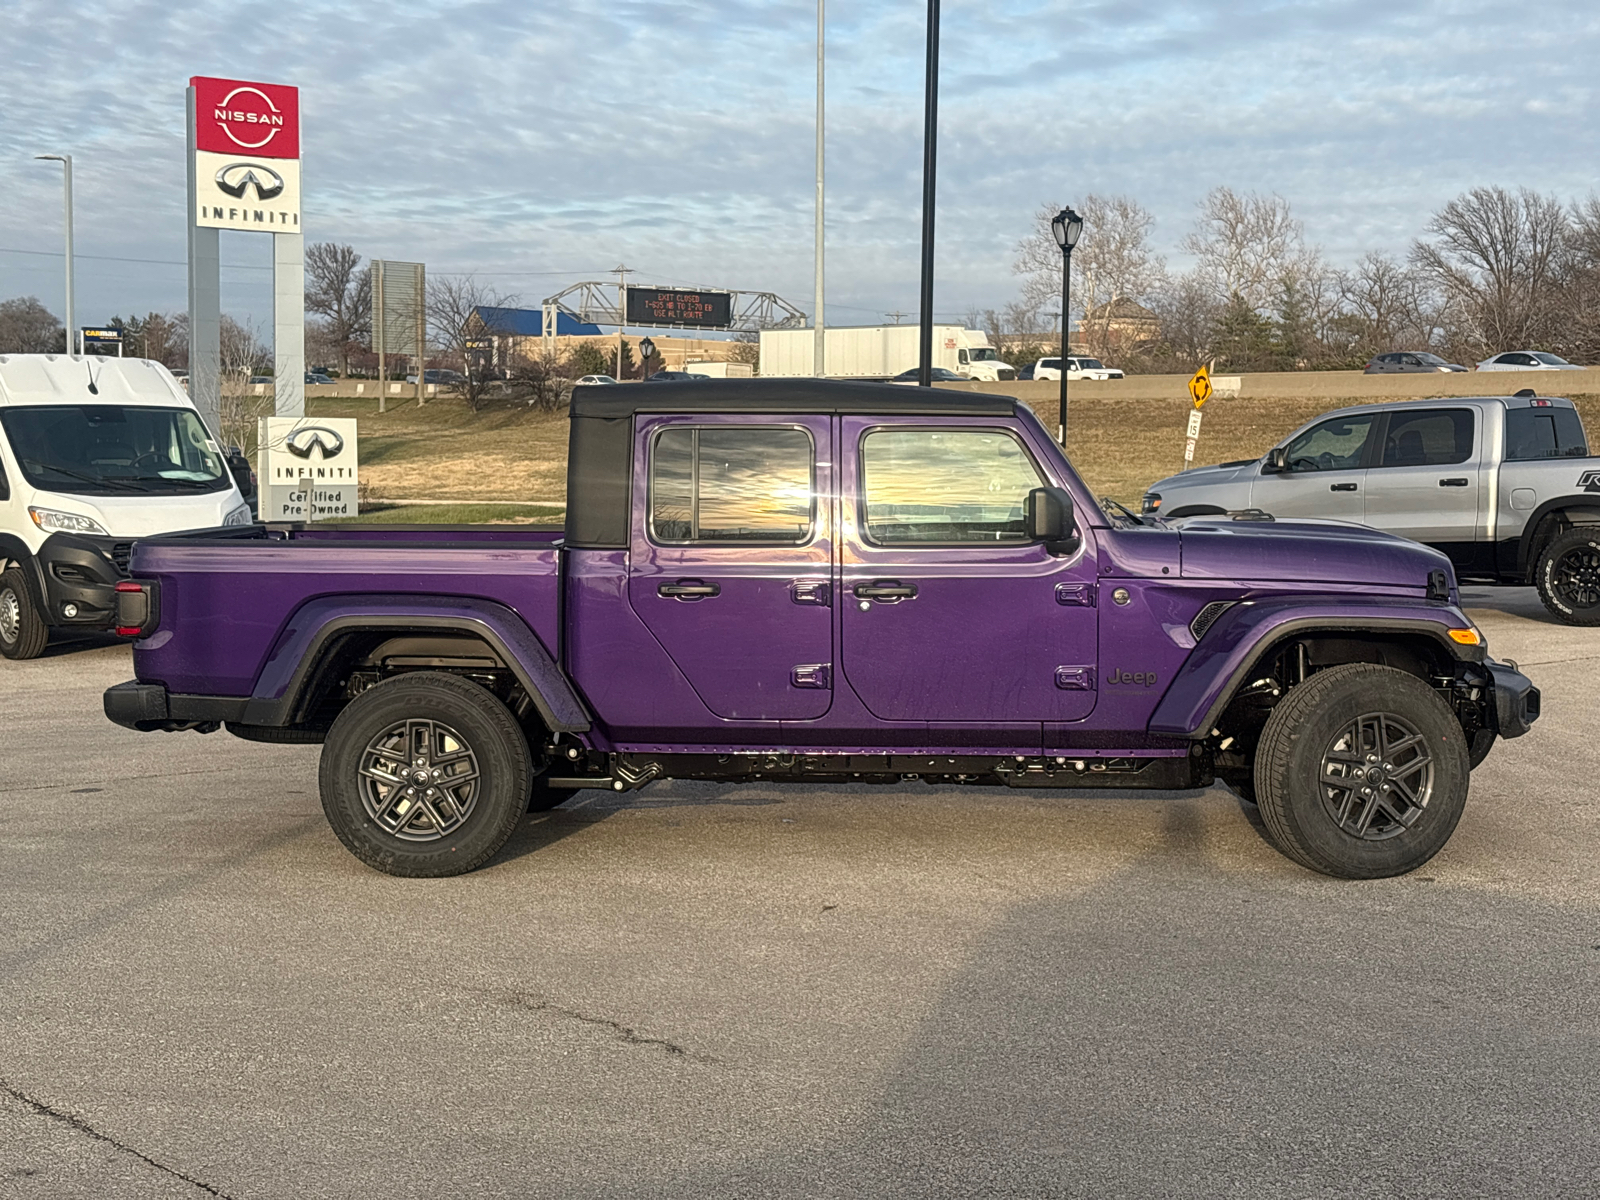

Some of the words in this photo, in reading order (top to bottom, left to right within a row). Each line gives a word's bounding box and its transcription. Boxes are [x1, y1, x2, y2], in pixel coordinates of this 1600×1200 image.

[214, 109, 283, 126] NISSAN
[202, 206, 298, 225] INFINITI
[658, 293, 674, 301] EXIT
[676, 294, 700, 303] CLOSED
[677, 302, 686, 310] TO
[653, 309, 666, 318] USE
[1190, 425, 1197, 435] 15
[277, 467, 352, 478] INFINITI
[289, 491, 341, 502] Cerified
[283, 503, 347, 515] Pre-Owned
[1107, 667, 1158, 687] Jeep
